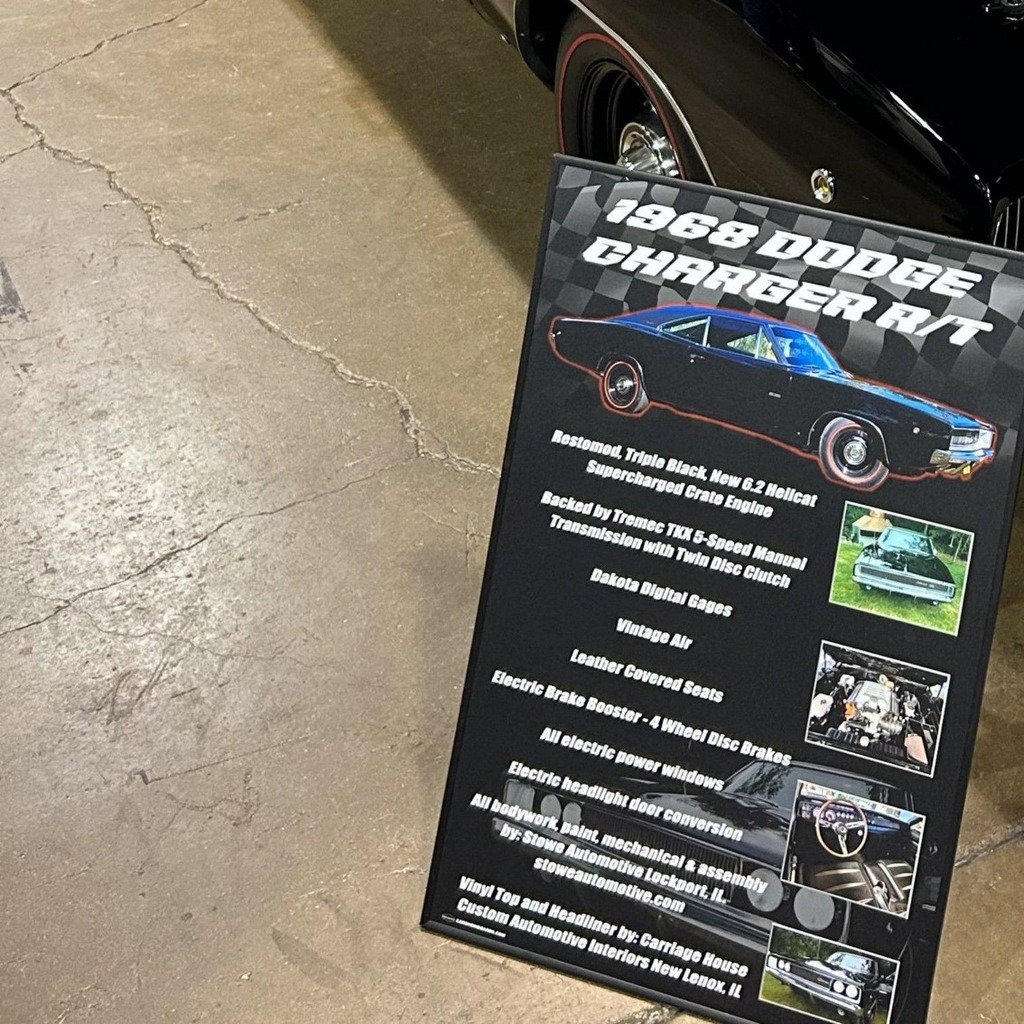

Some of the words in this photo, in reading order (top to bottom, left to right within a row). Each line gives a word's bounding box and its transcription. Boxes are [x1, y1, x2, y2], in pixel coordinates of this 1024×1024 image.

[606, 198, 760, 249] 1968
[756, 230, 983, 299] DODGE
[582, 236, 877, 322] CHARGER
[875, 301, 994, 346] R/T
[551, 429, 622, 459] Restomod,
[624, 447, 666, 469] Triple
[666, 458, 708, 481] Black,
[709, 468, 743, 488] New
[741, 477, 766, 494] 6.2
[764, 482, 819, 508] Hellcat
[586, 459, 686, 496] Supercharged
[684, 484, 725, 506] Crate
[724, 494, 774, 518] Engine
[540, 490, 594, 515] Backed
[593, 504, 612, 521] by
[612, 508, 666, 534] Tremec
[666, 522, 694, 541] TKX
[692, 529, 754, 556] 5-Speed
[752, 545, 808, 571] Manual
[550, 514, 643, 550] Transmission
[642, 539, 675, 558] with
[675, 546, 710, 567] Twin
[709, 556, 743, 576] Disc
[743, 564, 792, 589] Clutch
[590, 567, 640, 592] Dakota
[639, 581, 688, 605] Digital
[688, 594, 734, 617] Gages
[616, 617, 670, 644] Vintage
[669, 633, 693, 650] Air
[570, 648, 624, 675] Leather
[623, 664, 684, 691] Covered
[682, 680, 724, 703] Seats
[491, 669, 545, 696] Electric
[544, 685, 586, 708] Brake
[585, 697, 642, 723] Booster
[649, 715, 661, 729] 4
[661, 717, 708, 742] Wheel
[707, 730, 740, 752] Disc
[740, 740, 791, 767] Brakes
[539, 727, 562, 744] All
[561, 734, 616, 760] electric
[614, 749, 662, 773] power
[661, 763, 726, 792] windows
[507, 760, 562, 787] Electric
[561, 776, 630, 809] headlight
[629, 797, 664, 818] door
[663, 808, 744, 842] conversion
[470, 793, 492, 810] All
[490, 800, 560, 832] bodywork,
[560, 821, 600, 843] paint,
[601, 833, 686, 868] mechanical
[684, 858, 697, 872] &
[697, 863, 768, 894] assembly
[499, 823, 523, 842] by:
[522, 830, 566, 854] Stowe
[565, 843, 645, 877] Automotive
[644, 867, 709, 900] Lockport,
[533, 857, 686, 913] stoweautomotive.com
[456, 898, 510, 925] Custom
[509, 914, 588, 950] Automotive
[587, 938, 651, 969] Interiors
[650, 958, 683, 980] New
[681, 968, 727, 995] Lenox,
[727, 983, 743, 999] IL
[458, 875, 495, 898] Vinyl
[494, 887, 521, 906] Top
[520, 897, 550, 915] and
[548, 903, 618, 936] Headliner
[617, 925, 640, 943] by:
[639, 932, 702, 963] Carriage
[702, 952, 749, 978] House
